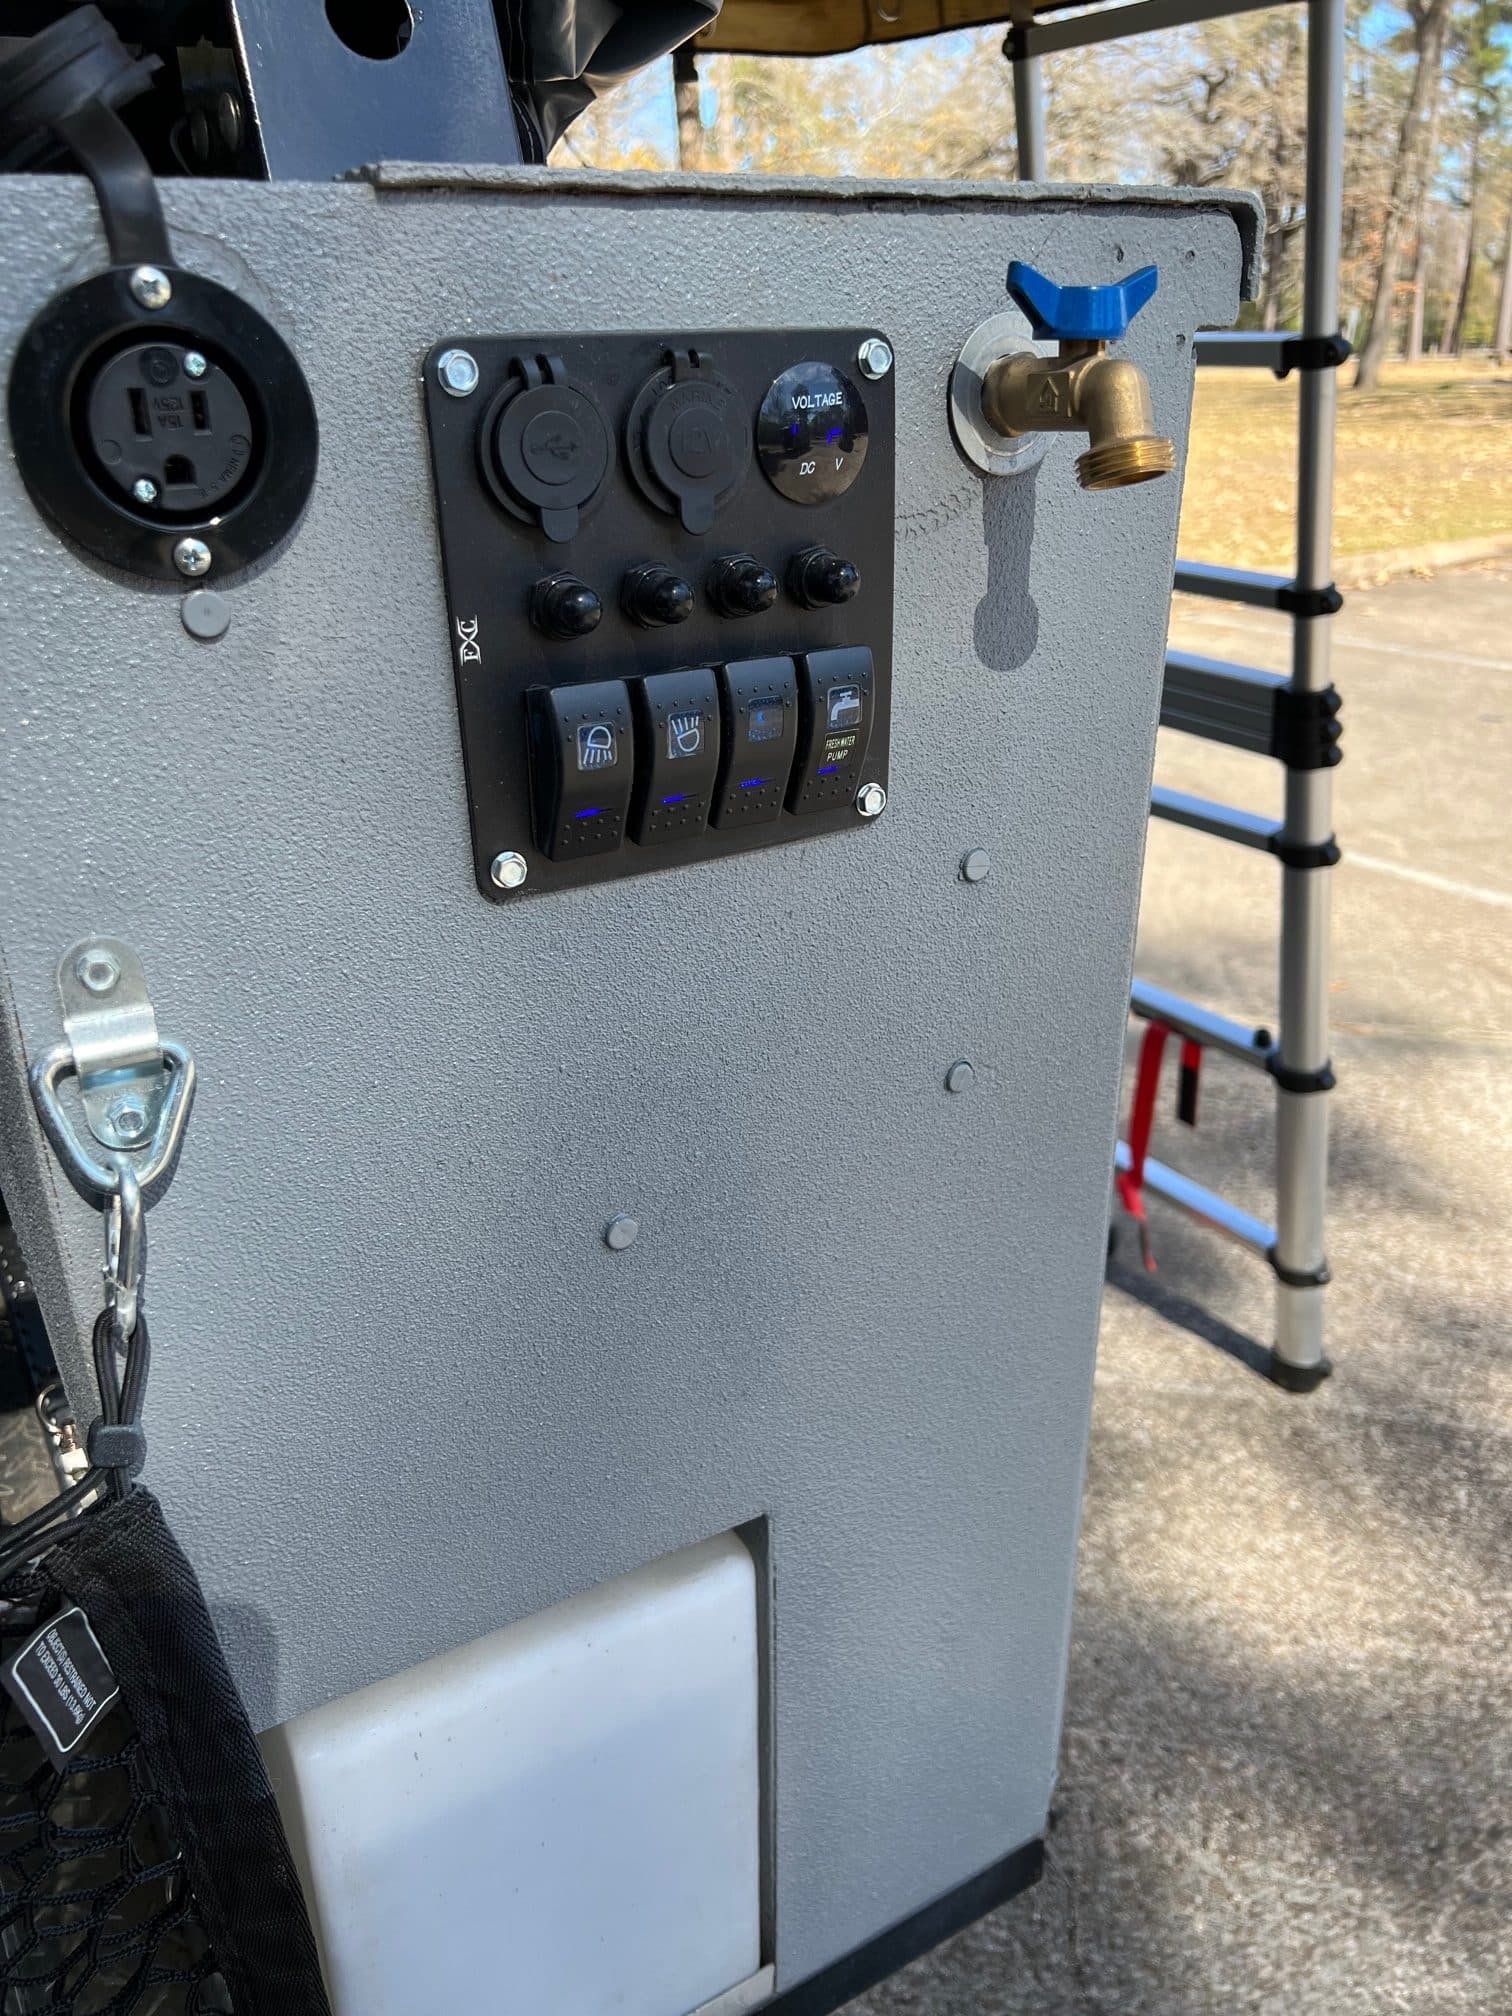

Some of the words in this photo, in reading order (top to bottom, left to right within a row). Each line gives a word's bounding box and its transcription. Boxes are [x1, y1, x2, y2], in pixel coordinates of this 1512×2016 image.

[792, 391, 843, 410] VOLTAGE
[800, 461, 816, 475] DC
[835, 457, 844, 471] V
[826, 749, 849, 762] PUMP
[35, 1640, 47, 1657] TO
[40, 1650, 59, 1680] EXCEED
[62, 1657, 88, 1699] RESTRAINED
[82, 1691, 97, 1712] NOT
